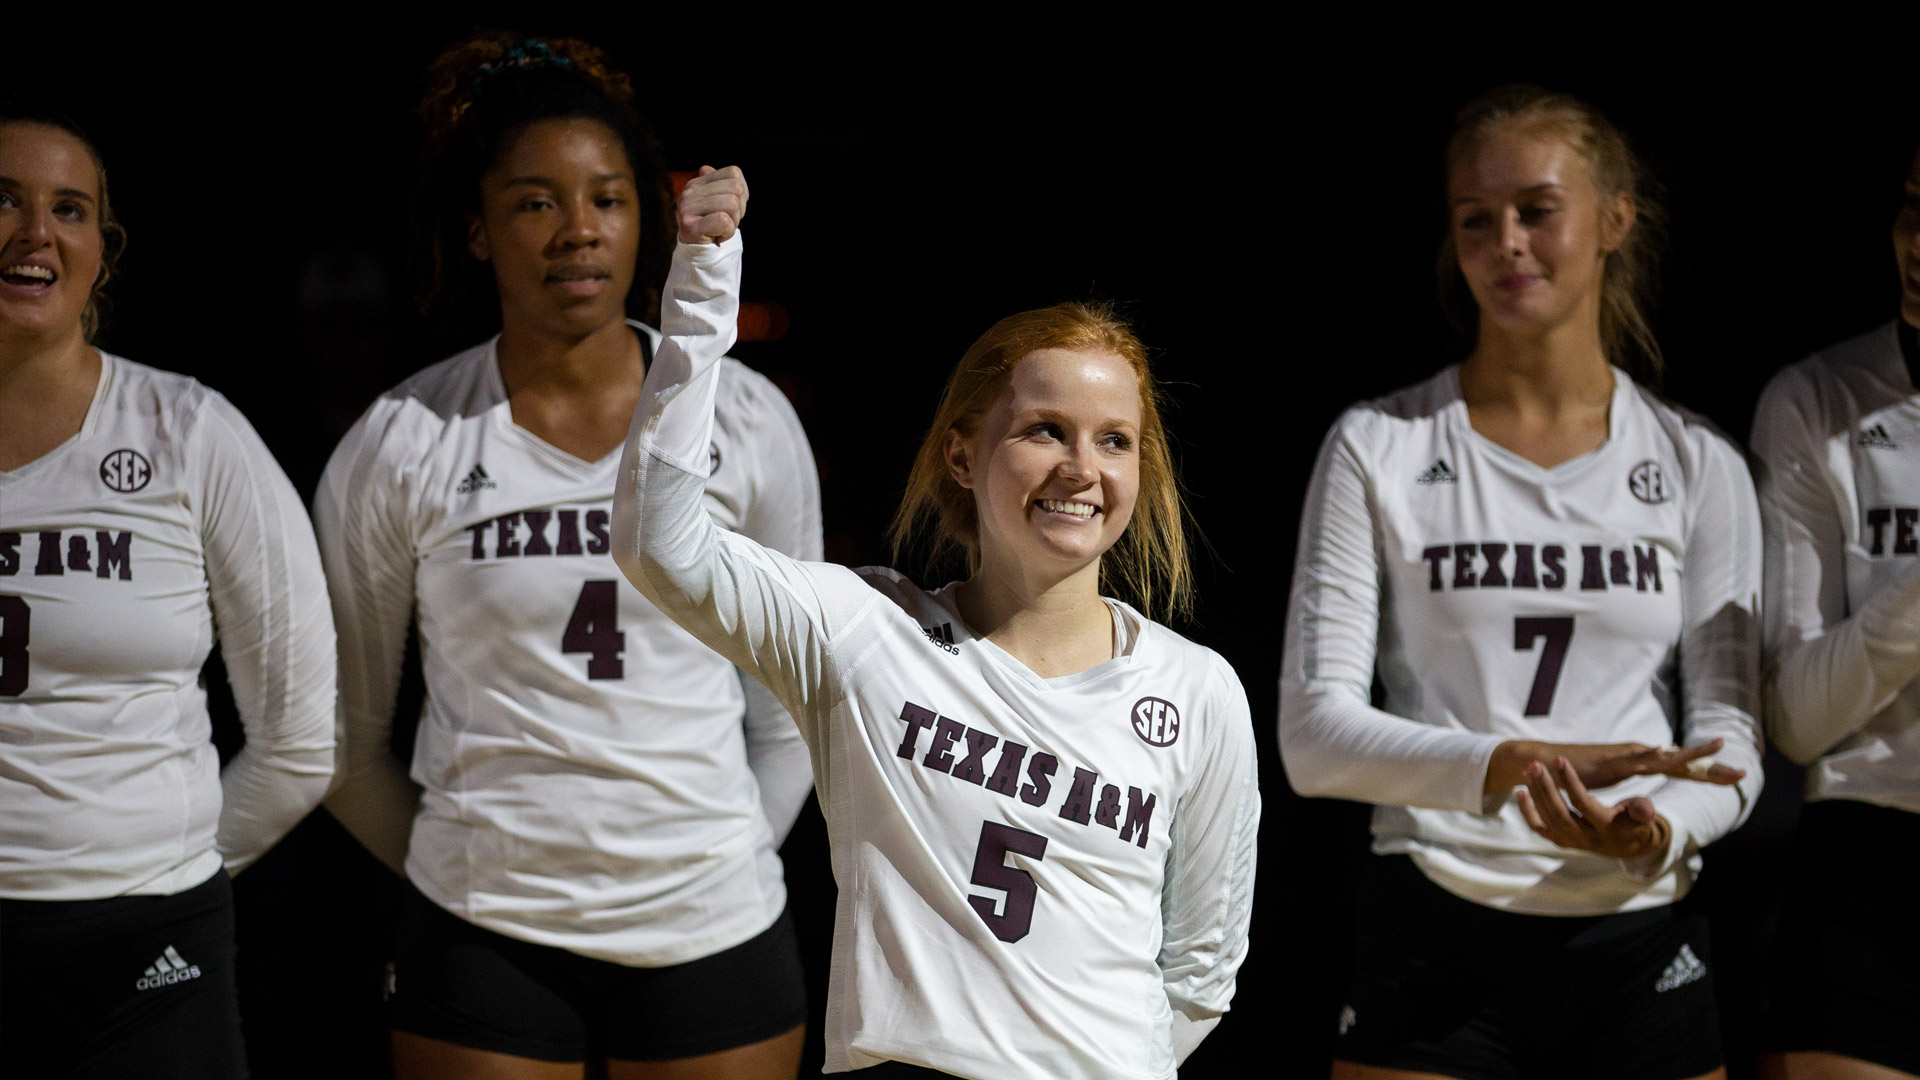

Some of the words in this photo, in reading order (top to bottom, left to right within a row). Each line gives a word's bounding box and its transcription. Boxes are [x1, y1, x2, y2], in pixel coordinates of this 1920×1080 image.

[102, 451, 149, 490] SEC
[1630, 461, 1670, 503] SE
[35, 532, 132, 580] A&M
[465, 510, 611, 559] TEXAS
[1423, 543, 1566, 591] TEXAS
[1580, 545, 1663, 592] A&M
[562, 580, 625, 680] 4
[918, 627, 960, 656] idas
[1514, 617, 1575, 717] 7
[1132, 698, 1179, 745] SEC
[897, 701, 1059, 808] TEXAS
[1059, 766, 1156, 849] A&M
[967, 820, 1048, 944] 5
[136, 965, 201, 990] adidas
